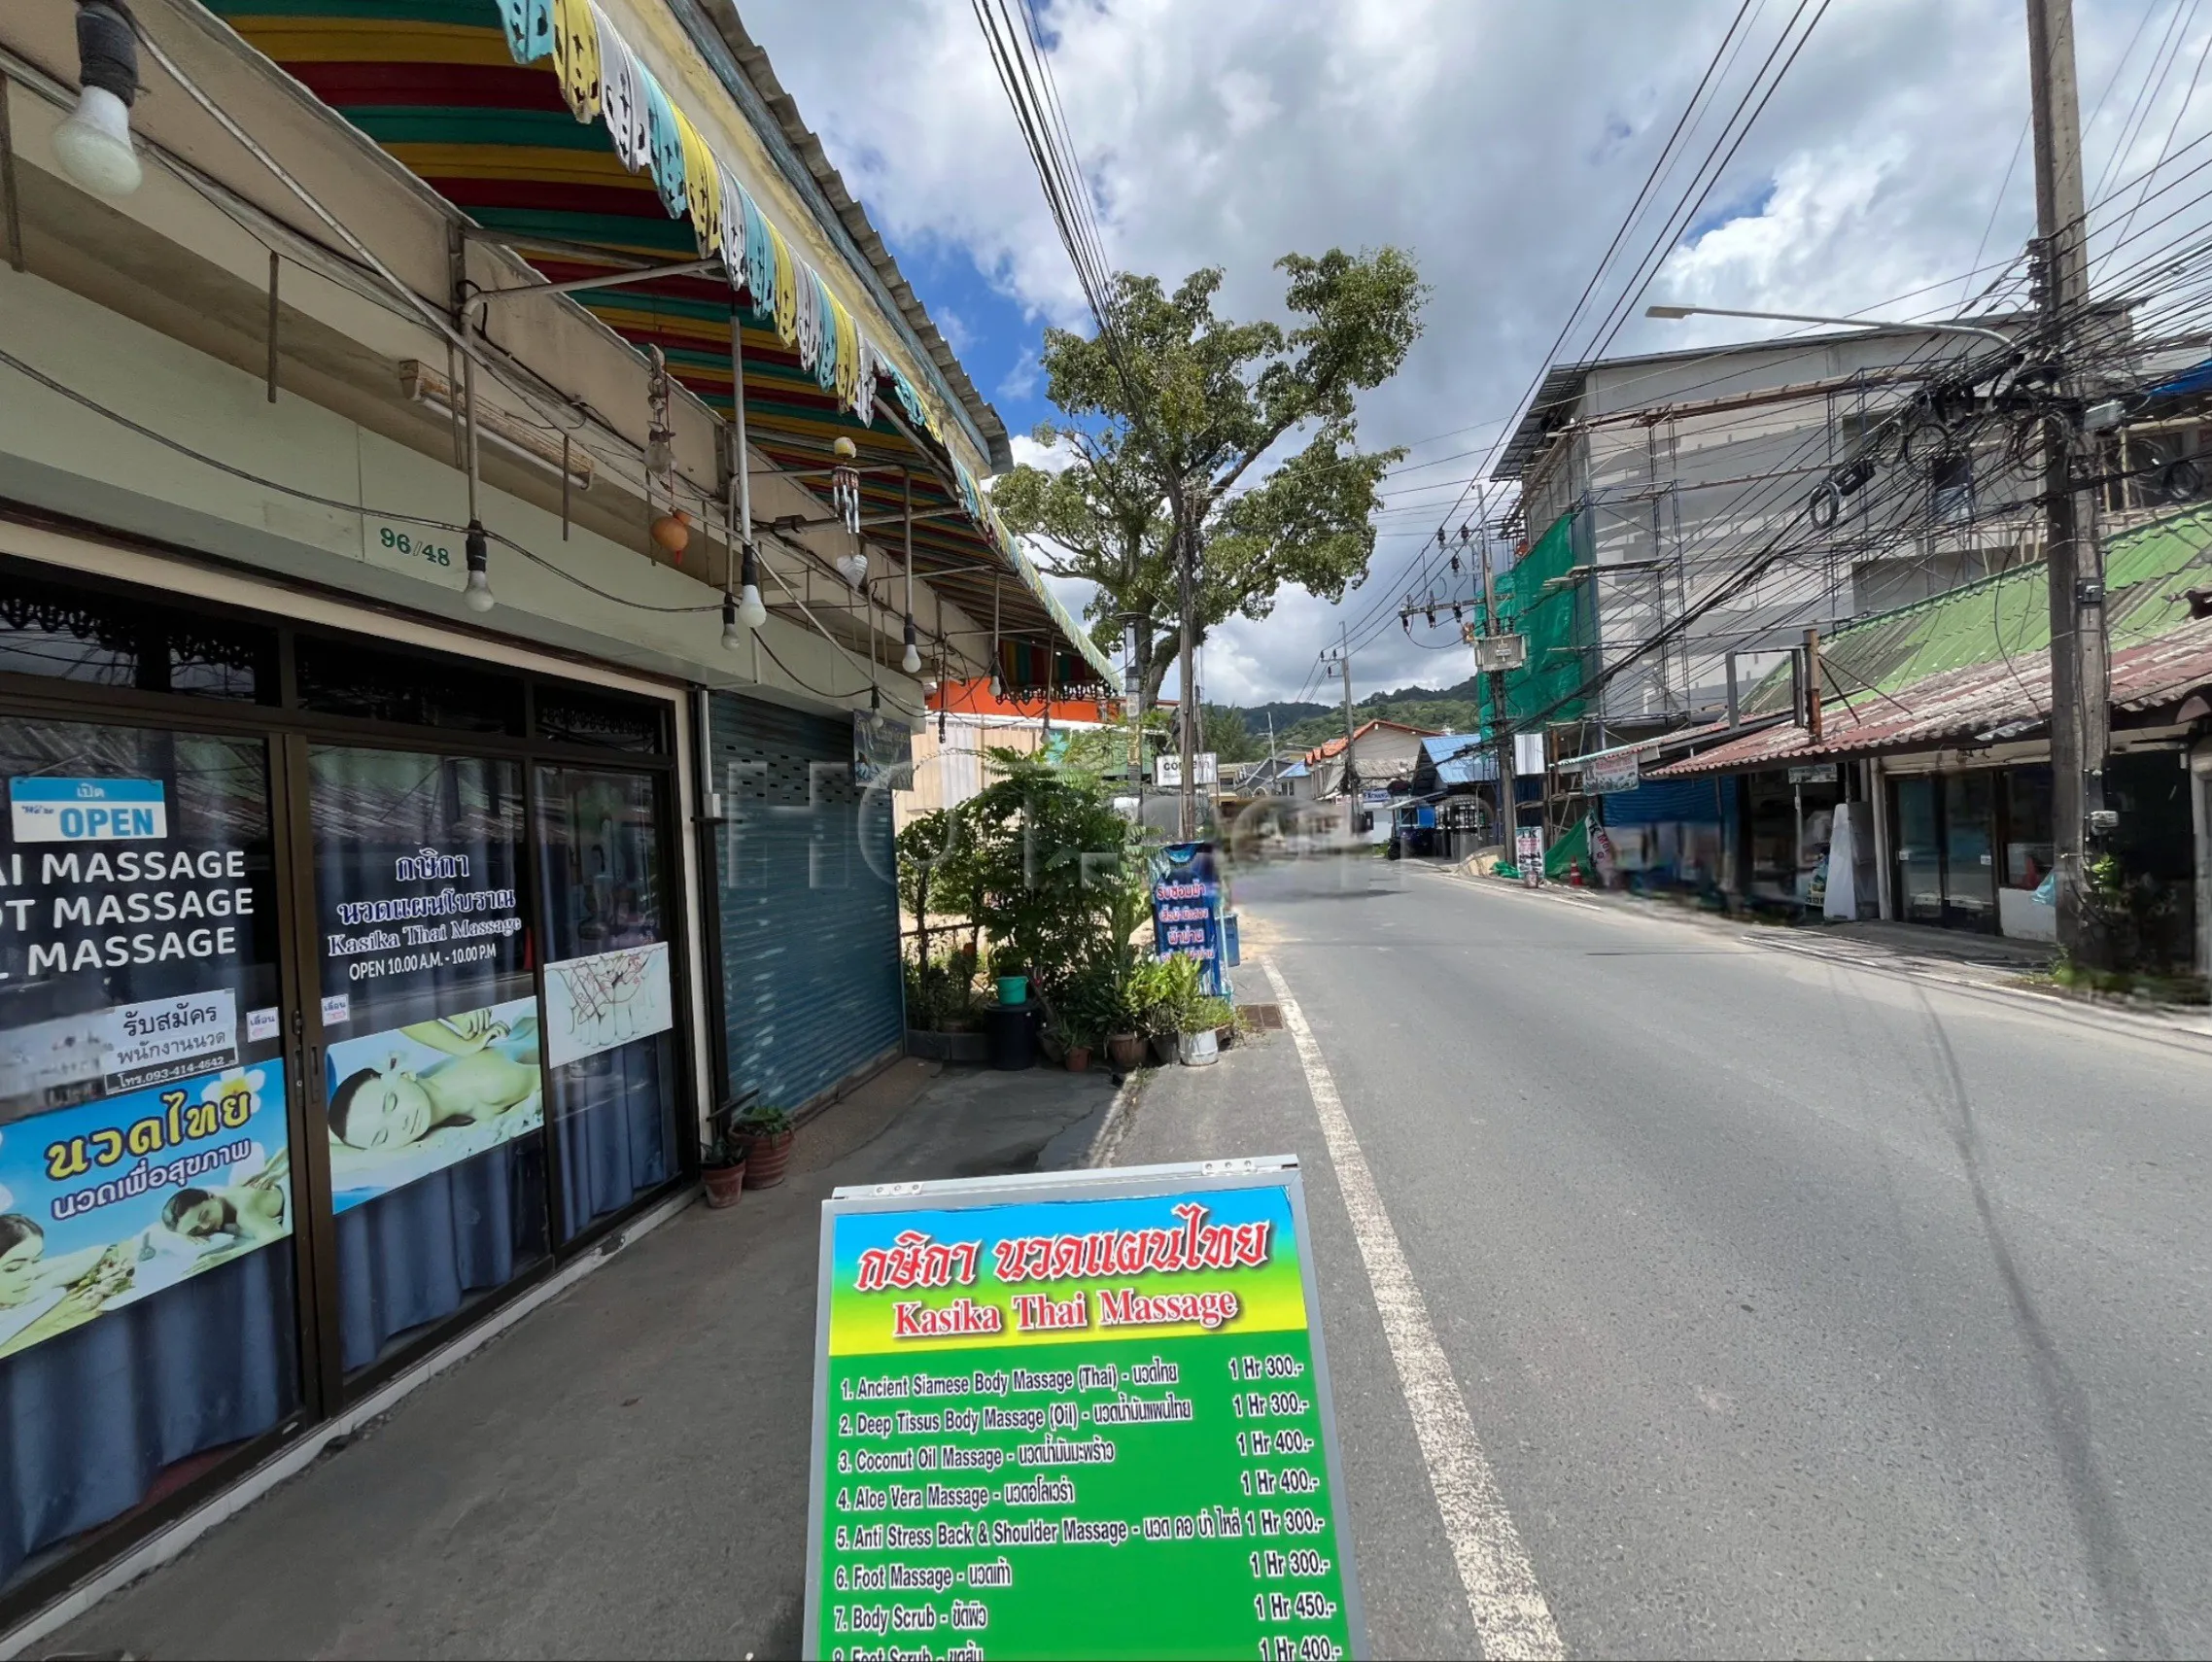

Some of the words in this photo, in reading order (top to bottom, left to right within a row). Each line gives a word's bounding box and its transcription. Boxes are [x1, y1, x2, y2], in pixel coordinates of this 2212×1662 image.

[380, 528, 451, 567] 96/48
[77, 782, 105, 798] เปิด
[59, 808, 154, 838] OPEN
[0, 853, 22, 885] I
[42, 850, 245, 884] MASSAGE
[396, 848, 469, 882] กษิกา
[0, 899, 36, 931] T
[53, 887, 254, 929] MASSAGE
[337, 887, 516, 925] นวดแผนโบราณ
[28, 926, 237, 976] MASSAGE
[328, 930, 401, 957] Kasika
[402, 924, 447, 946] Thai
[451, 918, 522, 940] Massage
[349, 959, 385, 981] OPEN
[389, 954, 418, 974] 10.00
[419, 952, 444, 970] A.M.
[451, 946, 478, 964] 10.00
[123, 1002, 217, 1036] รับสมัคร
[117, 1031, 225, 1064] พนักงานนวด
[45, 1090, 251, 1180] นวดไทย
[52, 1138, 252, 1220] นวดเพื่อสุขภาพ
[853, 1229, 982, 1291] กษิกา
[992, 1202, 1270, 1281] นวดแผนไทย
[893, 1298, 1001, 1337] Kasika
[1012, 1291, 1088, 1331] Thai
[1096, 1288, 1238, 1329] Massage
[842, 1379, 853, 1400] 1.
[856, 1376, 909, 1400] Ancient
[913, 1373, 969, 1396] Siamese
[974, 1369, 1008, 1396] Body
[1013, 1367, 1072, 1393] Massage
[1079, 1366, 1117, 1392] (Thai)
[1132, 1355, 1178, 1386] นวดไทย
[1229, 1358, 1239, 1380] 1
[1243, 1357, 1262, 1379] Hr
[840, 1413, 852, 1437] 2.
[856, 1413, 891, 1438] Deep
[896, 1410, 940, 1434] Tissus
[944, 1408, 979, 1435] Body
[984, 1406, 1044, 1433] Massage
[1049, 1402, 1078, 1432] (Oil)
[1093, 1392, 1192, 1424] นวดน้ำมันแผนไทย
[1233, 1396, 1243, 1417] 1
[1247, 1394, 1266, 1416] Hr
[839, 1451, 851, 1472] 3.
[856, 1448, 913, 1472] Coconut
[917, 1446, 937, 1470] Oil
[942, 1445, 1002, 1472] Massage
[1019, 1433, 1115, 1466] นวดน้ำมันมะพร้าว
[1237, 1434, 1247, 1455] 1
[1251, 1433, 1271, 1455] Hr
[837, 1487, 850, 1511] 4.
[854, 1486, 885, 1510] Aloe
[890, 1485, 922, 1508] Vera
[927, 1484, 988, 1512] Massage
[1004, 1474, 1075, 1505] นวดอโลเวร่า
[1241, 1471, 1252, 1495] 1
[1256, 1470, 1275, 1494] Hr
[835, 1526, 849, 1549] 5.
[853, 1524, 883, 1549] Anti
[887, 1523, 933, 1547] Stress
[937, 1521, 974, 1547] Back
[978, 1520, 989, 1545] &
[993, 1517, 1057, 1544] Shoulder
[1062, 1517, 1127, 1545] Massage
[1143, 1517, 1172, 1540] นวด
[1174, 1515, 1193, 1540] คอ
[1246, 1511, 1256, 1535] 1
[1261, 1510, 1280, 1534] Hr
[835, 1567, 849, 1590] 6.
[852, 1564, 885, 1589] Foot
[889, 1563, 952, 1592] Massage
[968, 1556, 1012, 1586] นวดเท้า
[1250, 1552, 1261, 1577] 1
[1264, 1550, 1285, 1576] Hr
[834, 1605, 847, 1631] 7.
[851, 1605, 888, 1636] Body
[893, 1604, 936, 1630] Scrub
[951, 1600, 987, 1629] ขัดผิว
[1255, 1594, 1265, 1620] 1
[1269, 1593, 1291, 1620] Hr
[1259, 1637, 1269, 1661] 1
[1274, 1636, 1296, 1661] Hr
